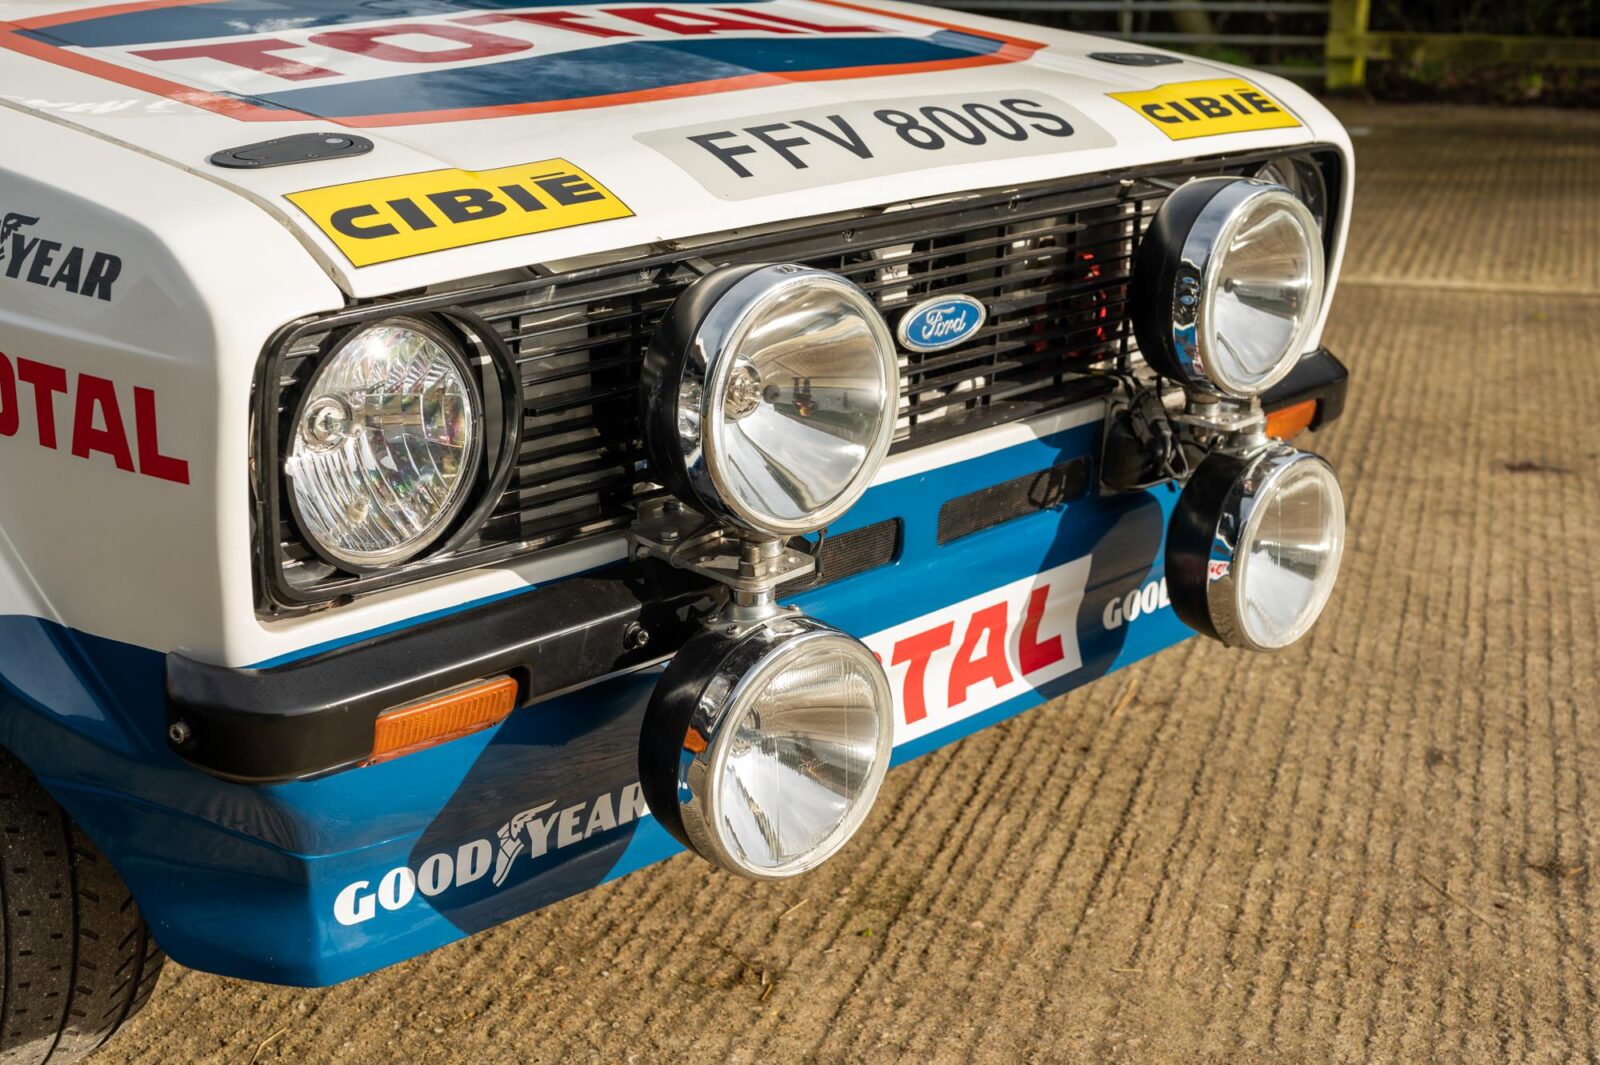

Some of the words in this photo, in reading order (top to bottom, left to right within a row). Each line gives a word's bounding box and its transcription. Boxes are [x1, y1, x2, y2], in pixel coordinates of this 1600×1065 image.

[126, 8, 889, 82] TOTAL
[686, 114, 874, 179] FFV
[873, 98, 1075, 151] 800S
[922, 306, 966, 340] Ford
[874, 583, 1065, 725] TAL
